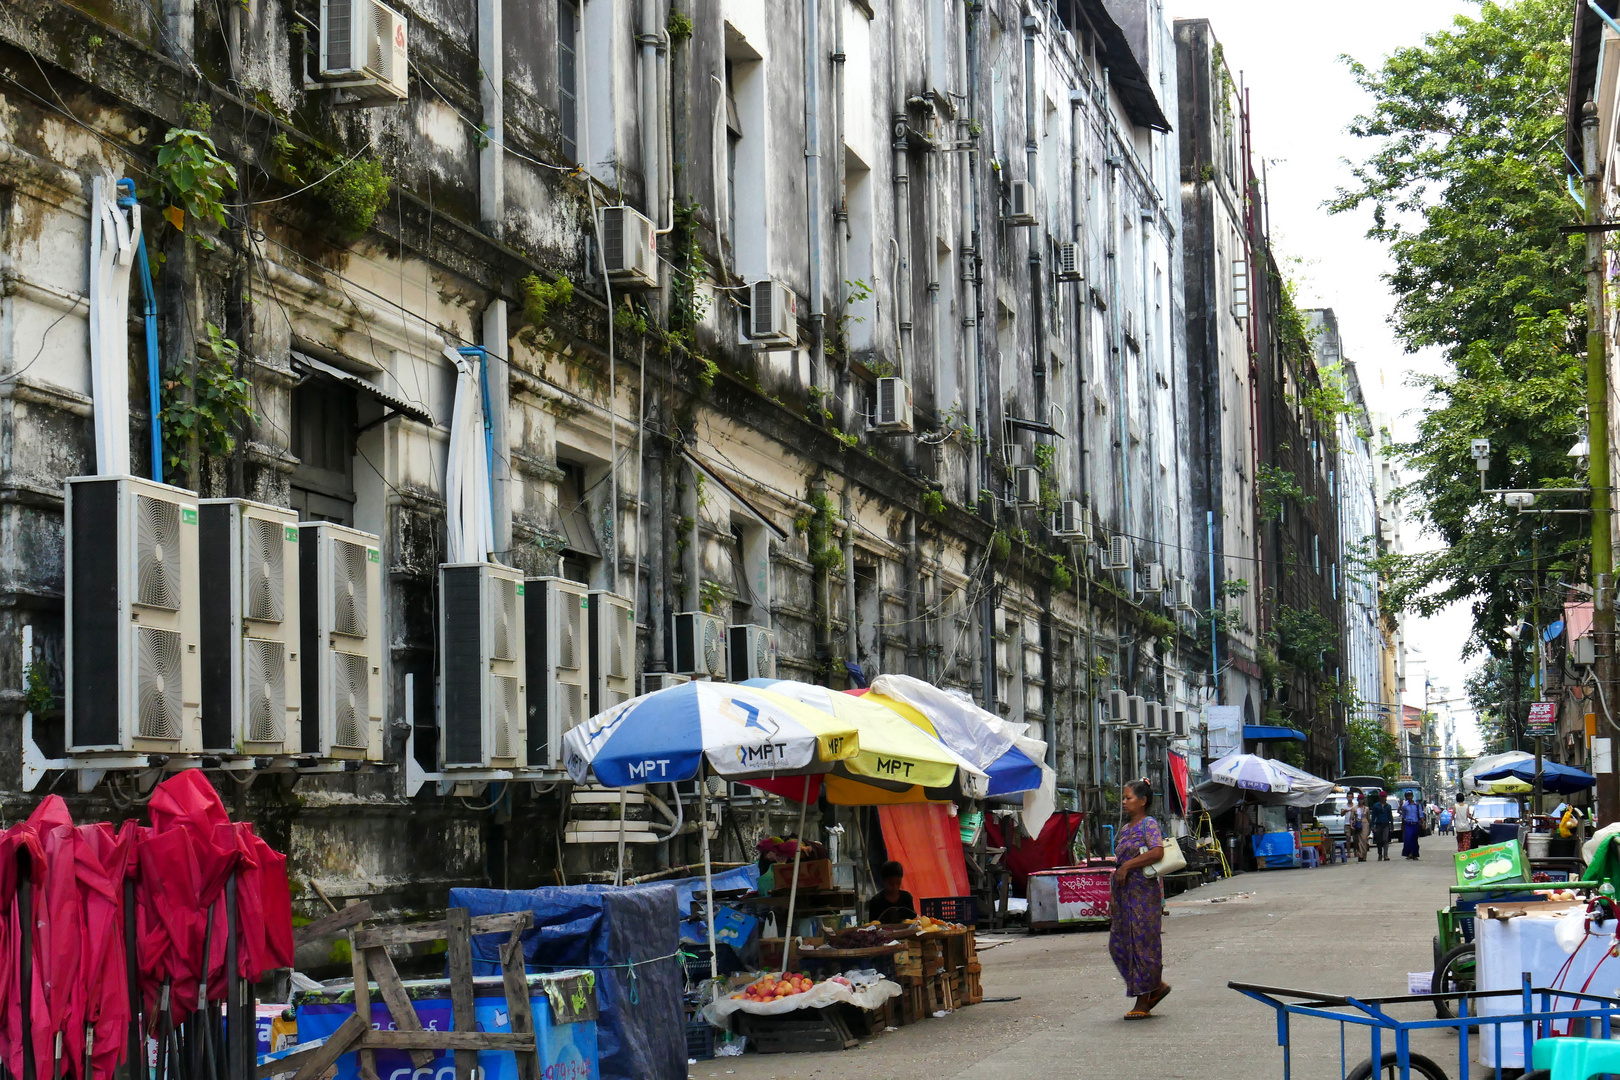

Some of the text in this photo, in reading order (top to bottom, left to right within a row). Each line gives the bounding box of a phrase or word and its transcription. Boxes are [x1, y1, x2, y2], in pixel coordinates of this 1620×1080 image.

[748, 743, 787, 761] MPT
[828, 736, 844, 754] MPT
[628, 759, 671, 779] MPT
[876, 757, 915, 778] MPT
[1247, 781, 1264, 790] MPT
